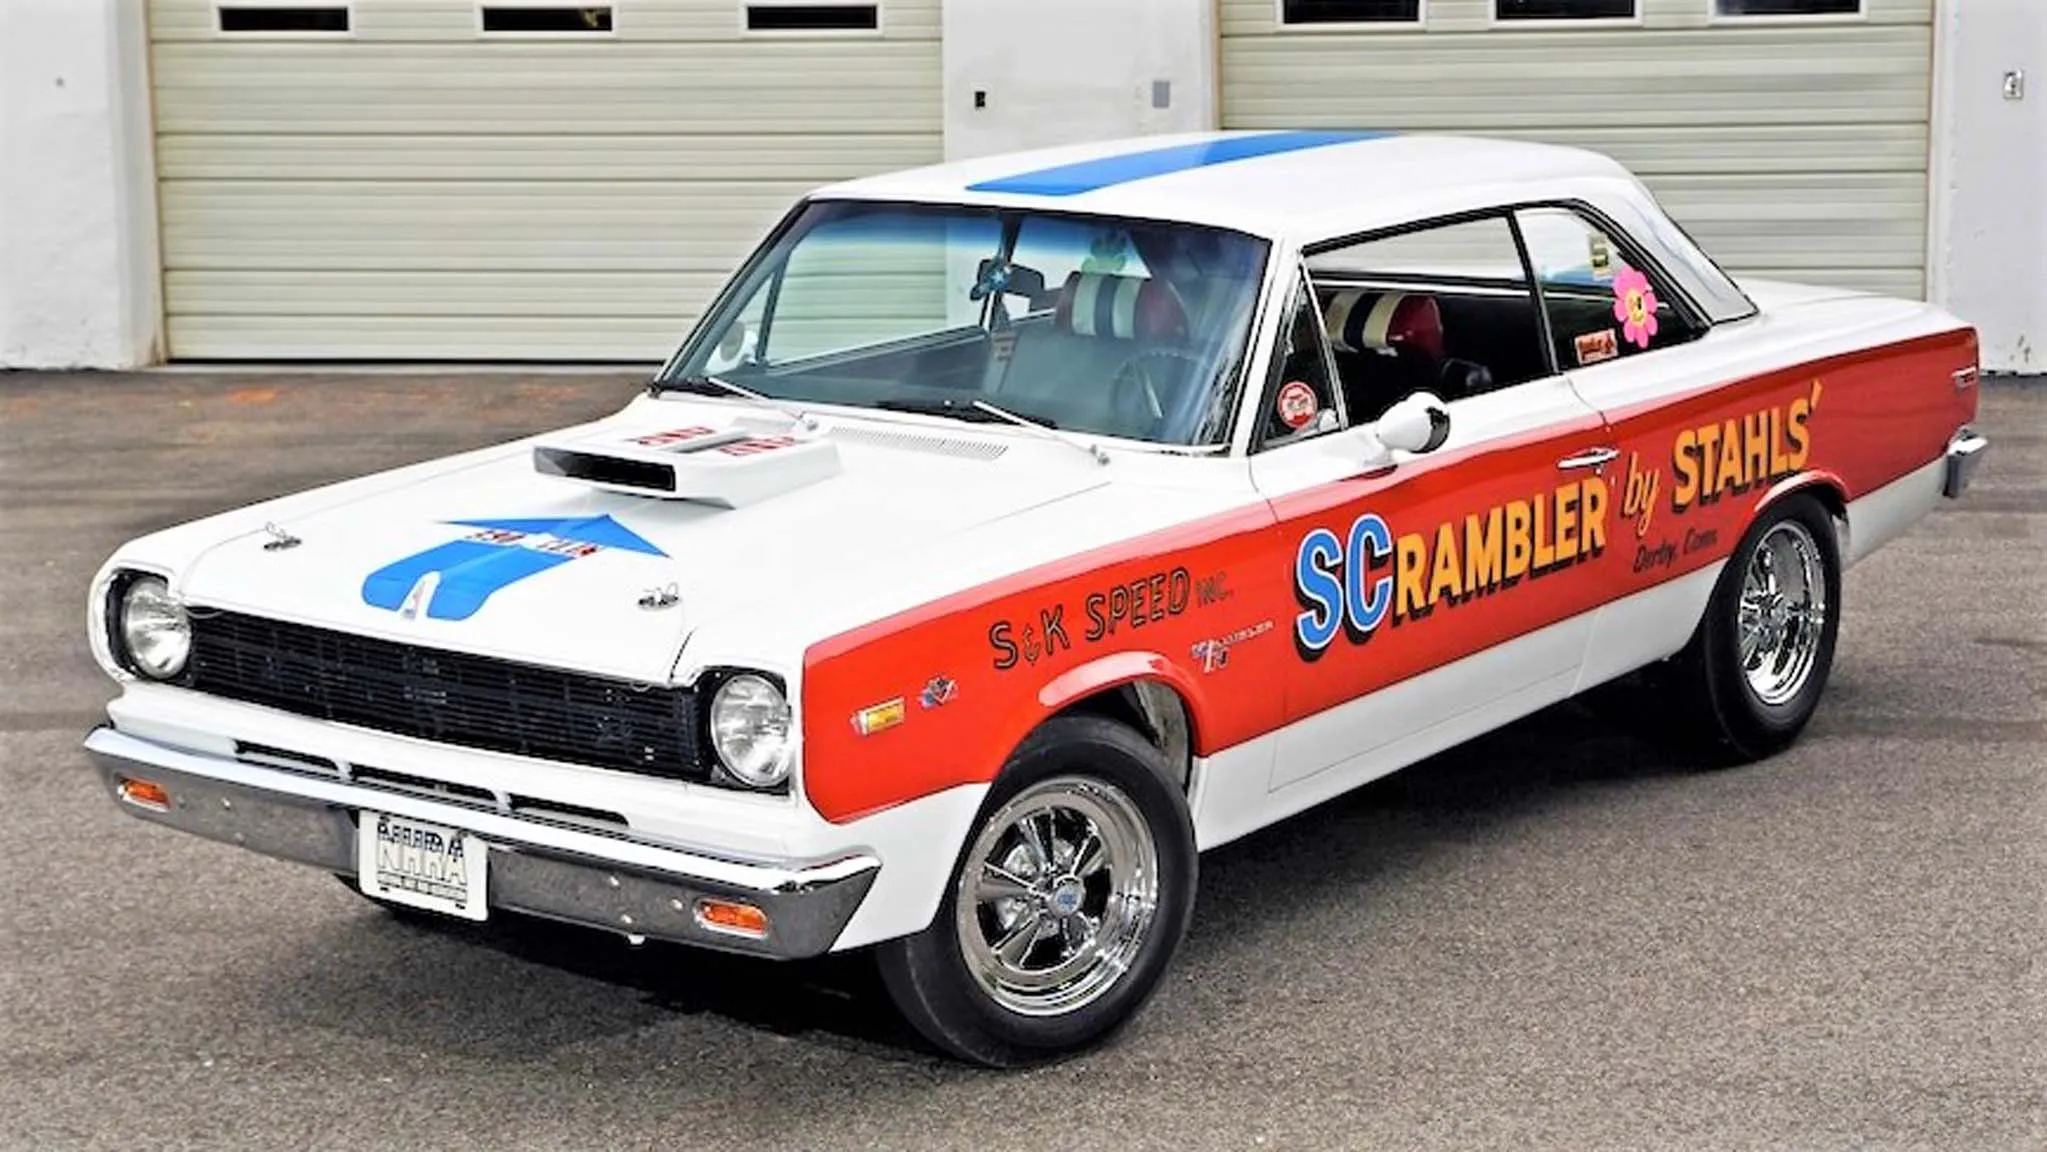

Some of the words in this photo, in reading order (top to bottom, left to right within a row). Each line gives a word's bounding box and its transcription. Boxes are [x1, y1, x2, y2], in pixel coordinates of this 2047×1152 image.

[1085, 566, 1192, 643] SPEED
[1294, 476, 1606, 660] SCRAMBLER
[1623, 451, 1661, 538] by
[1672, 377, 1824, 513] STAHLS'
